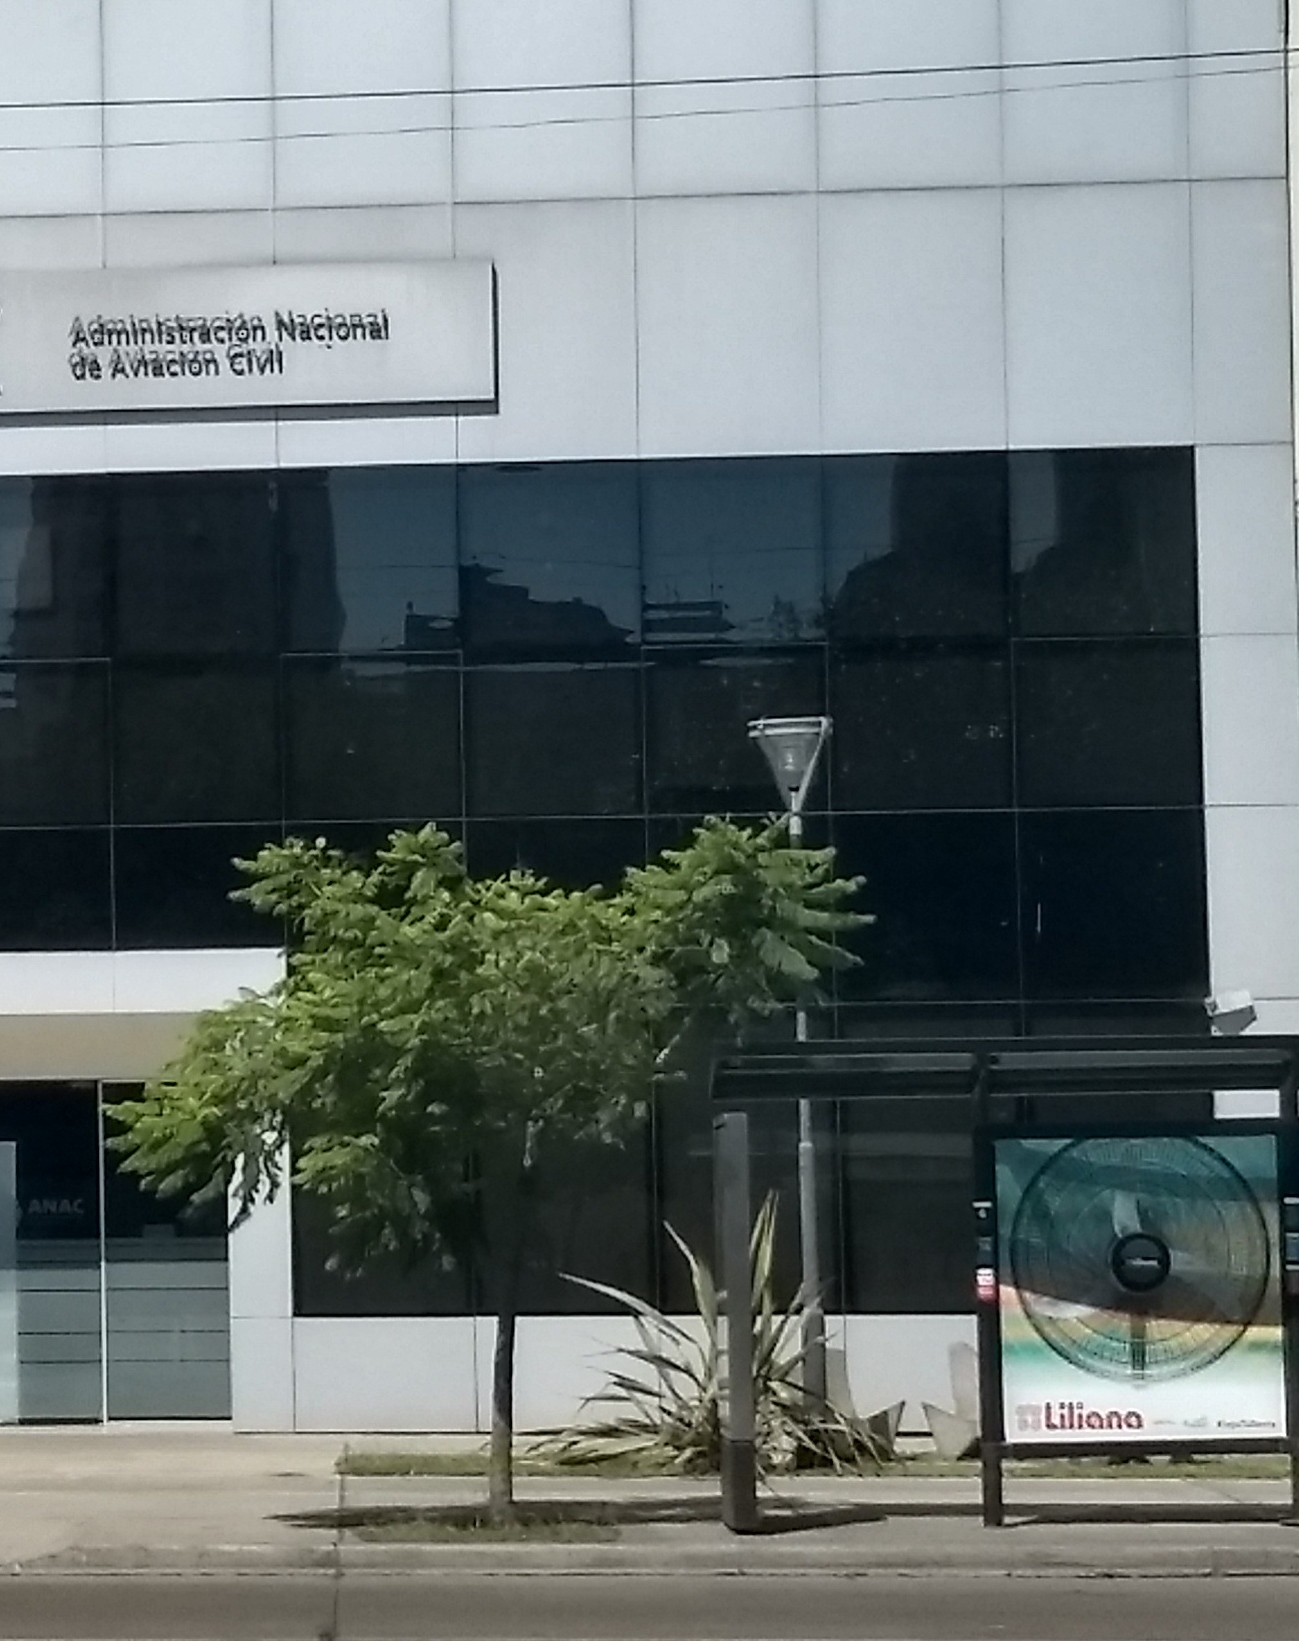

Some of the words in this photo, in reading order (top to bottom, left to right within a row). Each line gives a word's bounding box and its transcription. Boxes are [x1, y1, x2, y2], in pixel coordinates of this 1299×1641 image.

[68, 311, 267, 348] Administración
[274, 307, 390, 343] Nacional
[69, 349, 102, 381] de
[108, 347, 220, 380] Aviación
[227, 342, 285, 377] Civil
[27, 1198, 84, 1214] ANAC
[1044, 1401, 1144, 1430] Liliana
